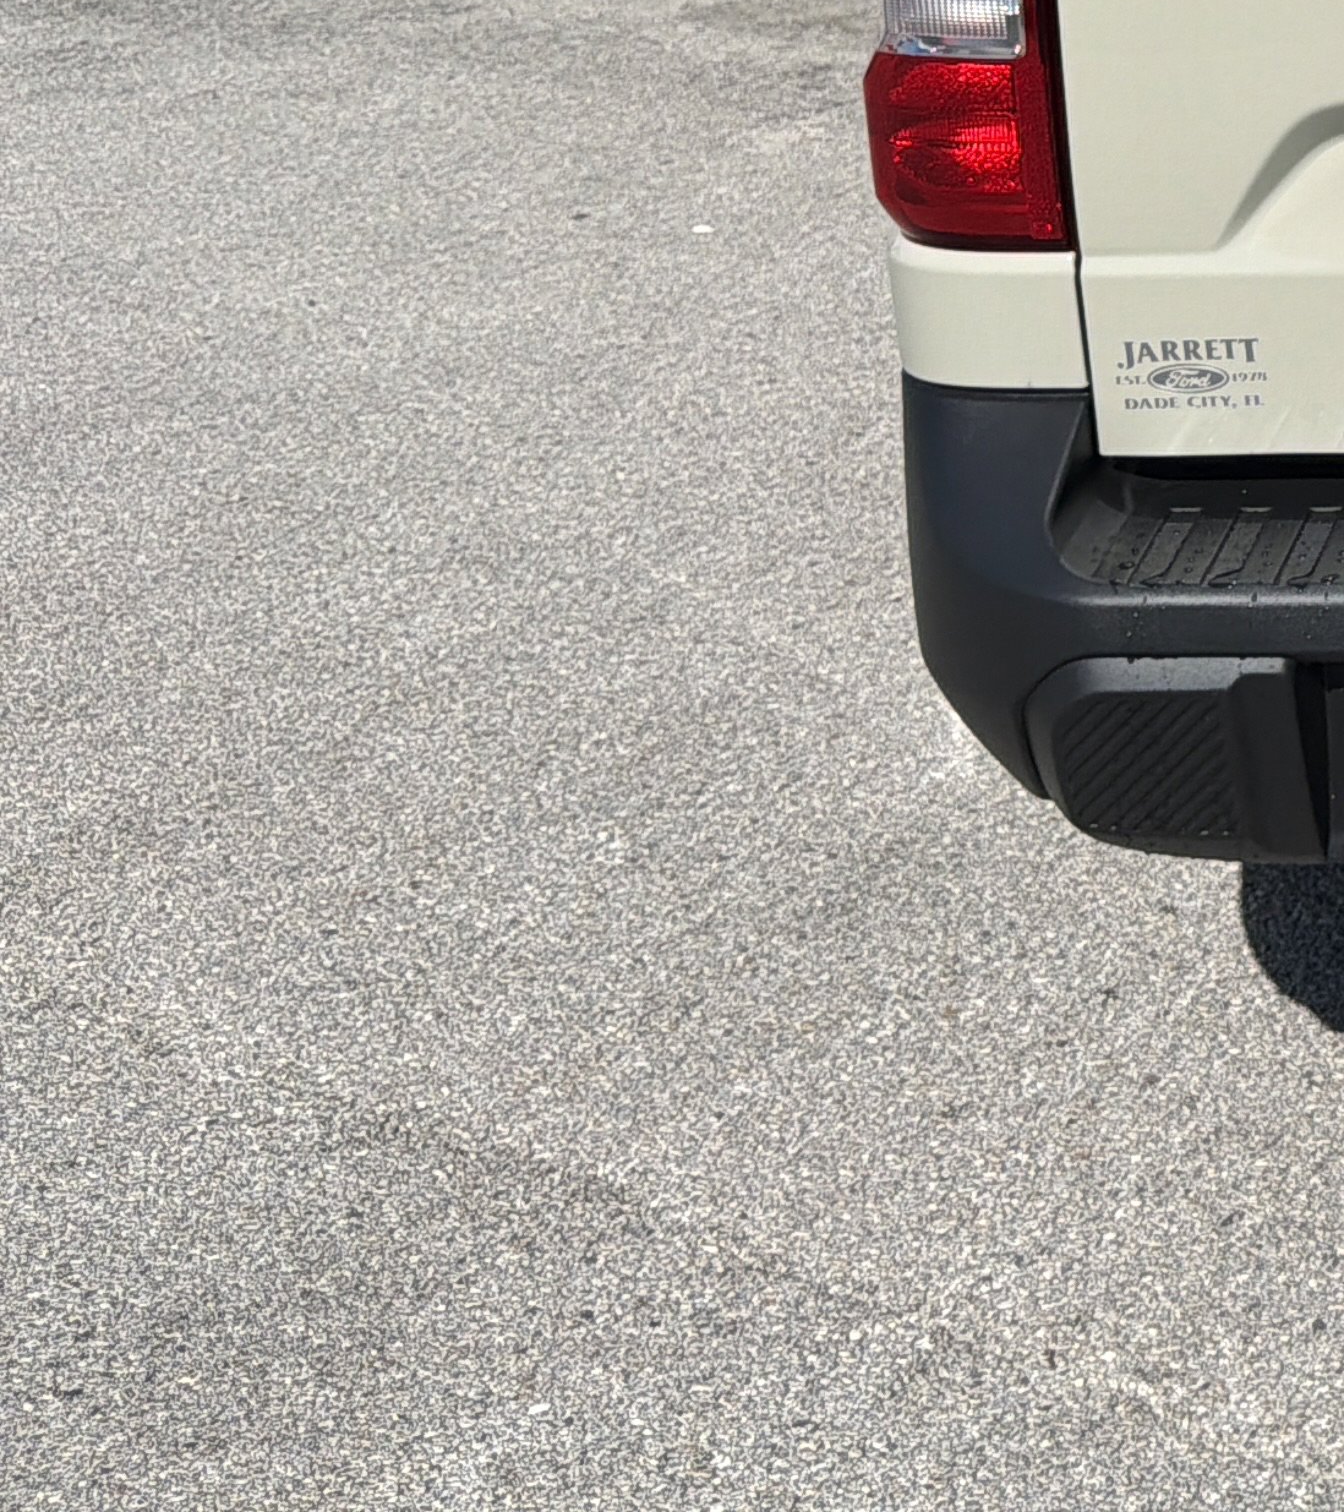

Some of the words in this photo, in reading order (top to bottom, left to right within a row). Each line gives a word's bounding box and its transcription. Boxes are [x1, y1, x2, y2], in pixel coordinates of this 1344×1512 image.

[1116, 337, 1260, 370] JARRETT
[1165, 369, 1212, 388] Ford
[1124, 396, 1181, 410] DADE
